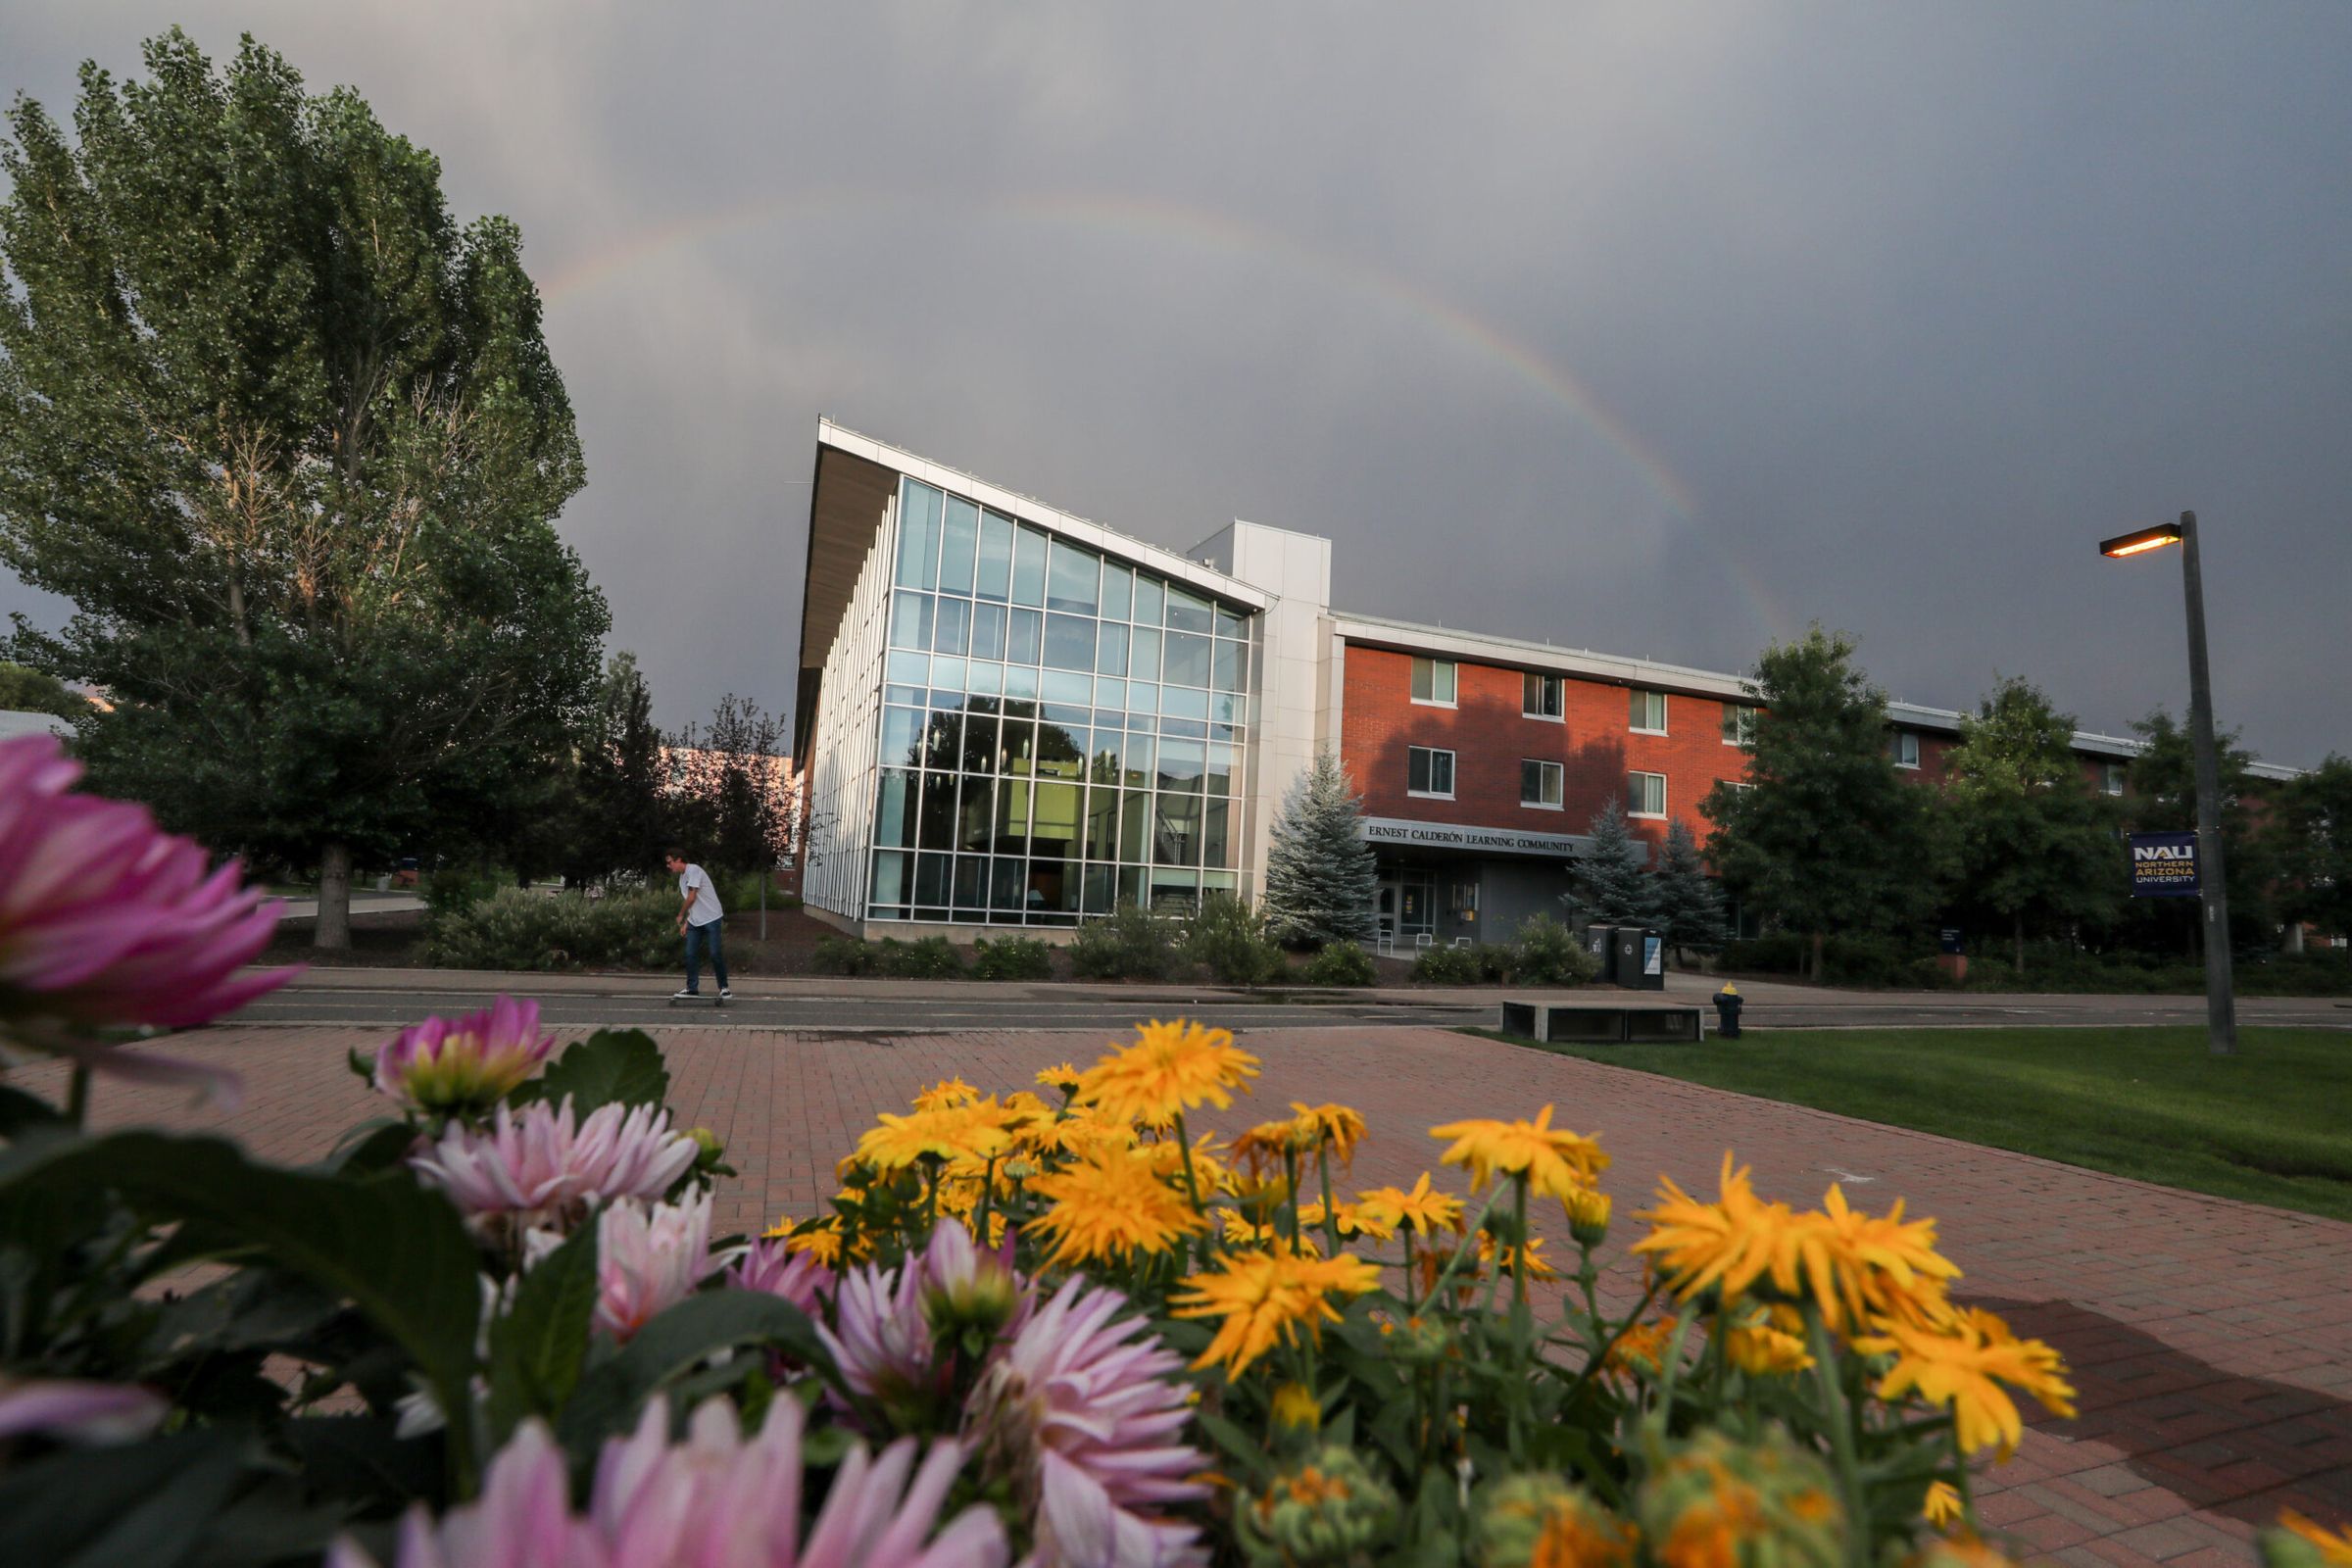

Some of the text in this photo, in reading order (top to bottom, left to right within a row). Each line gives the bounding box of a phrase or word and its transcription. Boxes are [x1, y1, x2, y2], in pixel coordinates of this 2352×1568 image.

[1369, 825, 1574, 852] ERNEST CALDERÓN LEARNING COMMUNITY
[2133, 846, 2193, 859] NAU
[2136, 867, 2195, 876] ARIZONA
